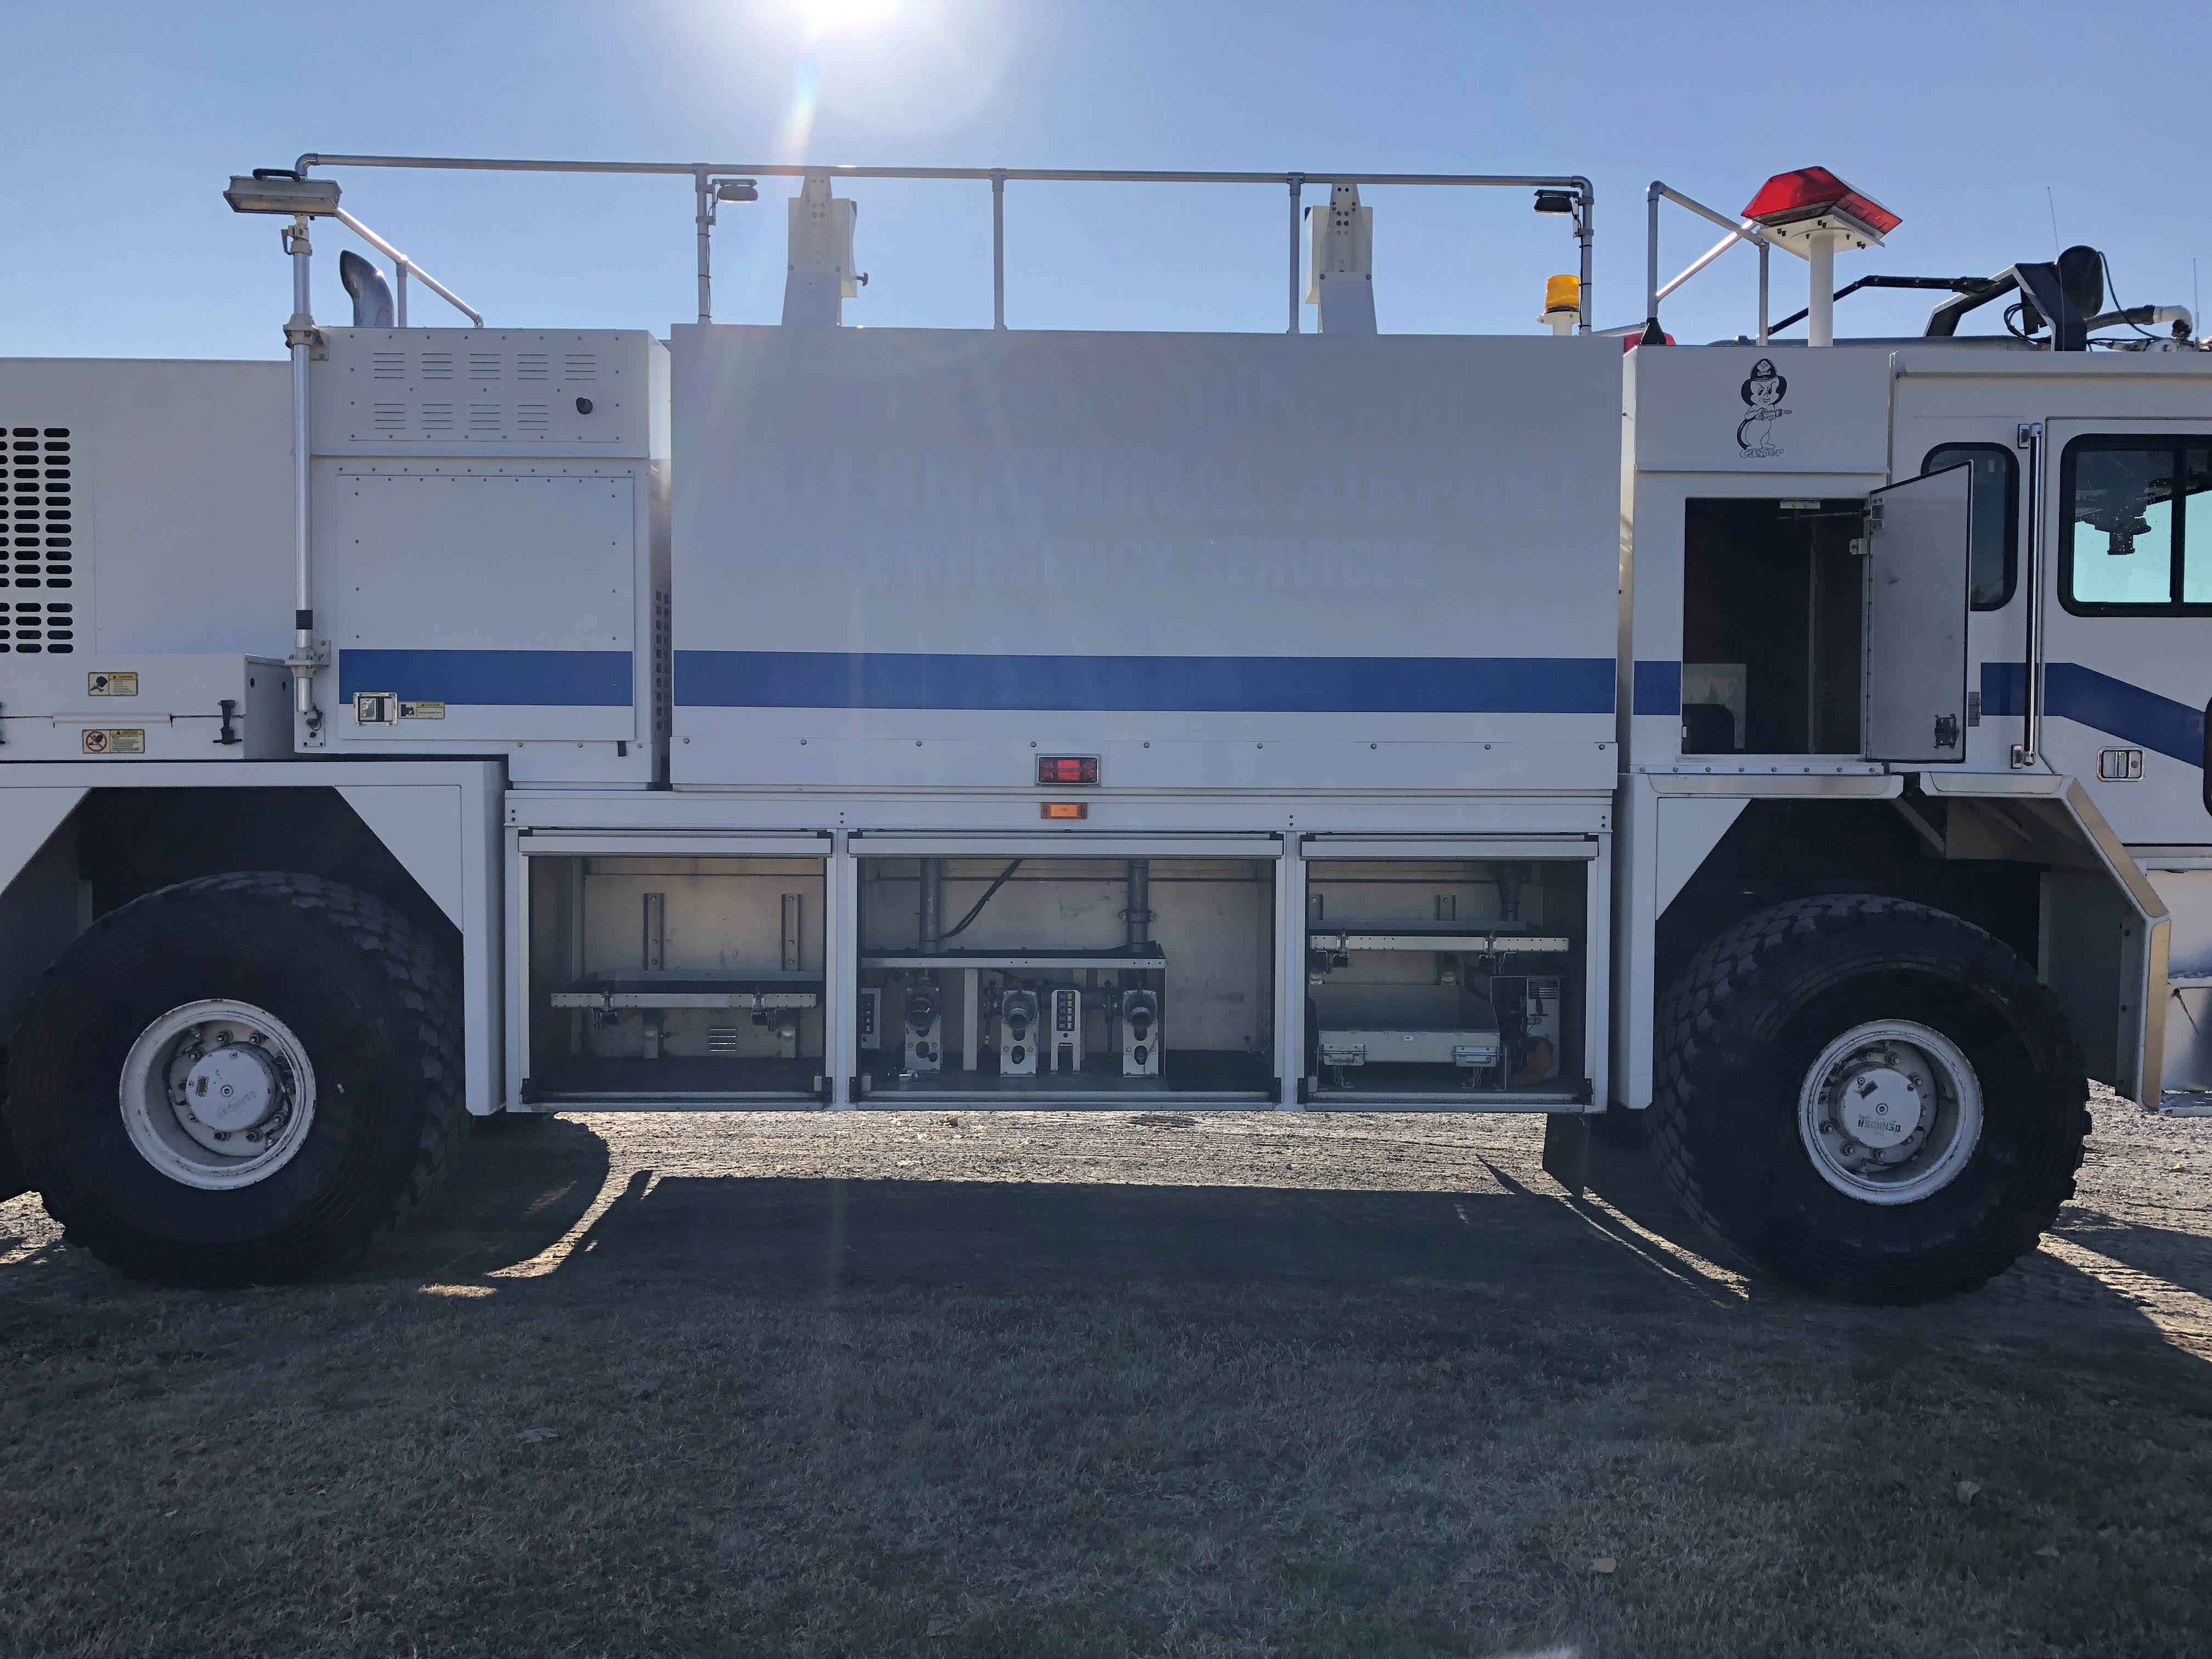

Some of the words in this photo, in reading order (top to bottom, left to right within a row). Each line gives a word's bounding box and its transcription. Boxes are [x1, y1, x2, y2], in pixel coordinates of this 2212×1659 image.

[1293, 452, 1588, 521] AIRPORT
[865, 535, 1173, 586] EMERGENCY
[1194, 538, 1431, 588] SERVICES
